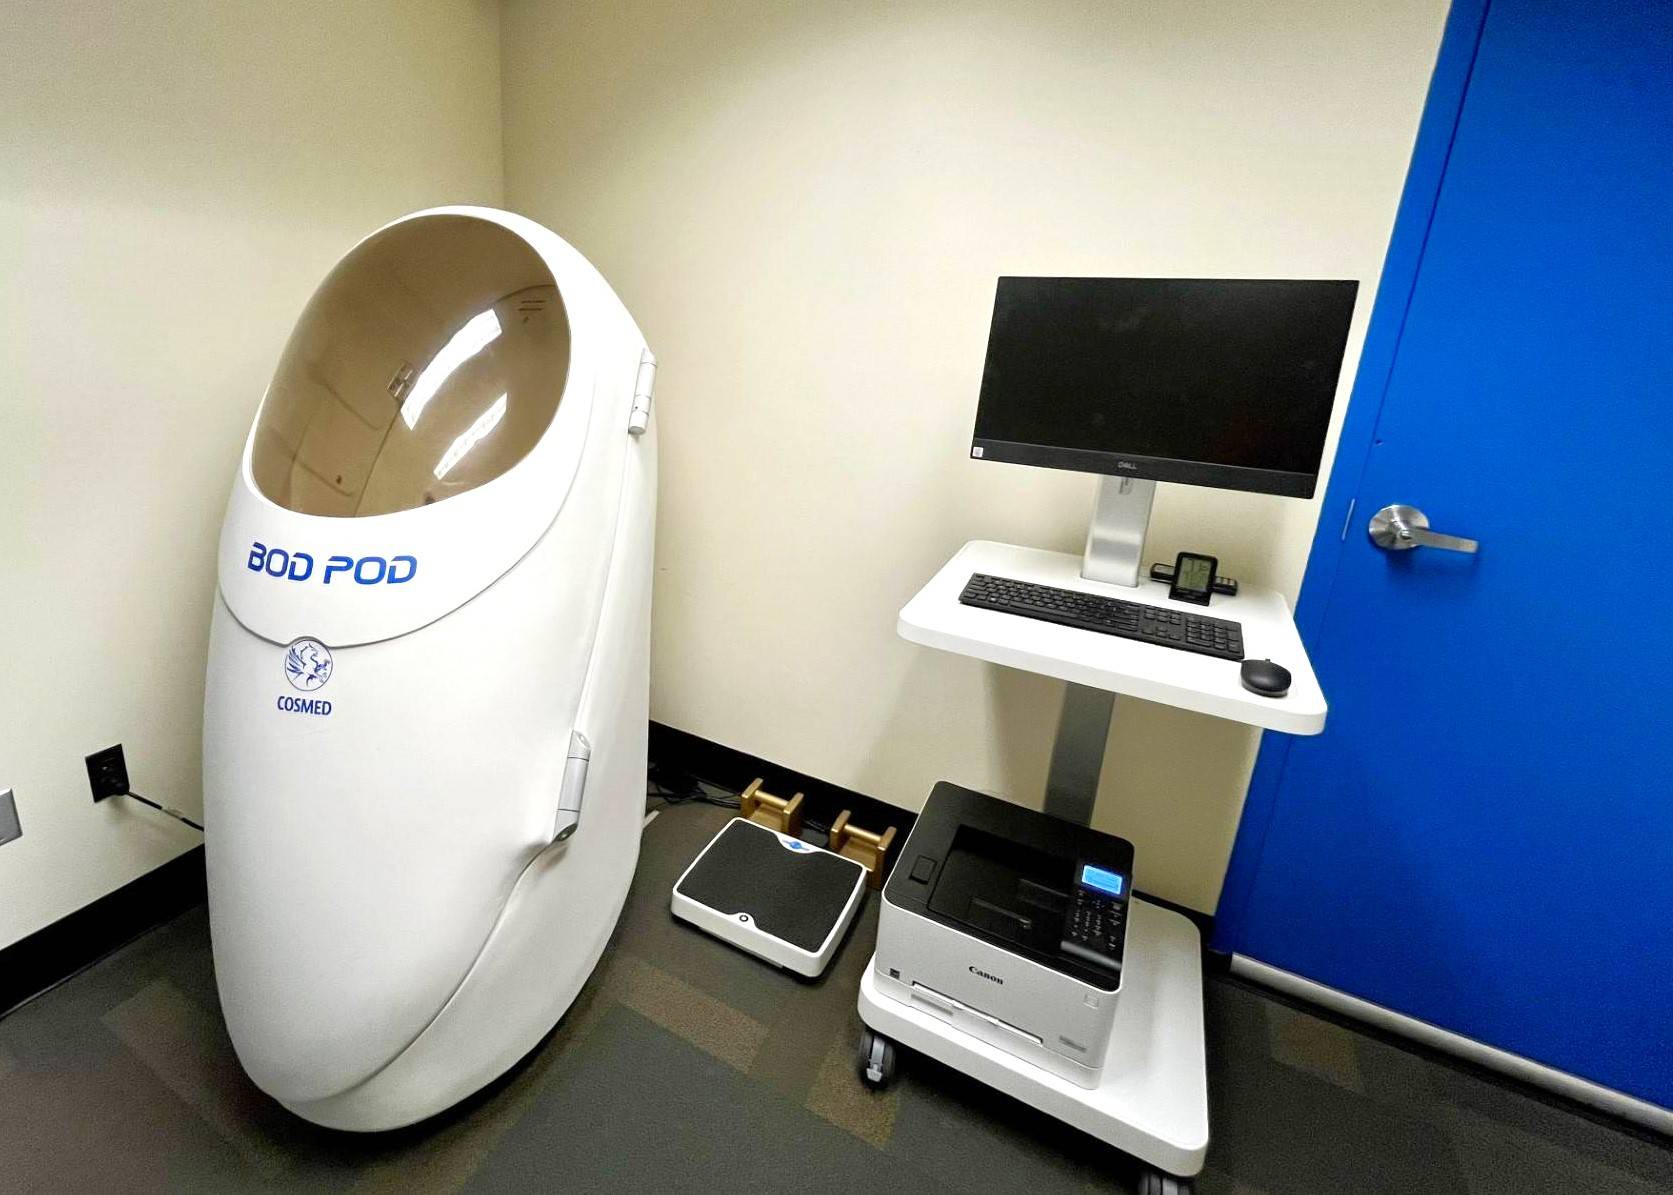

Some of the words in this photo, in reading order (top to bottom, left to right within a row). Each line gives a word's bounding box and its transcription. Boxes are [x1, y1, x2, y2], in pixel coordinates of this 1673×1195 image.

[247, 541, 314, 582] BOD
[323, 555, 418, 585] POD
[277, 695, 332, 716] COSMED
[968, 965, 1004, 985] Canon
